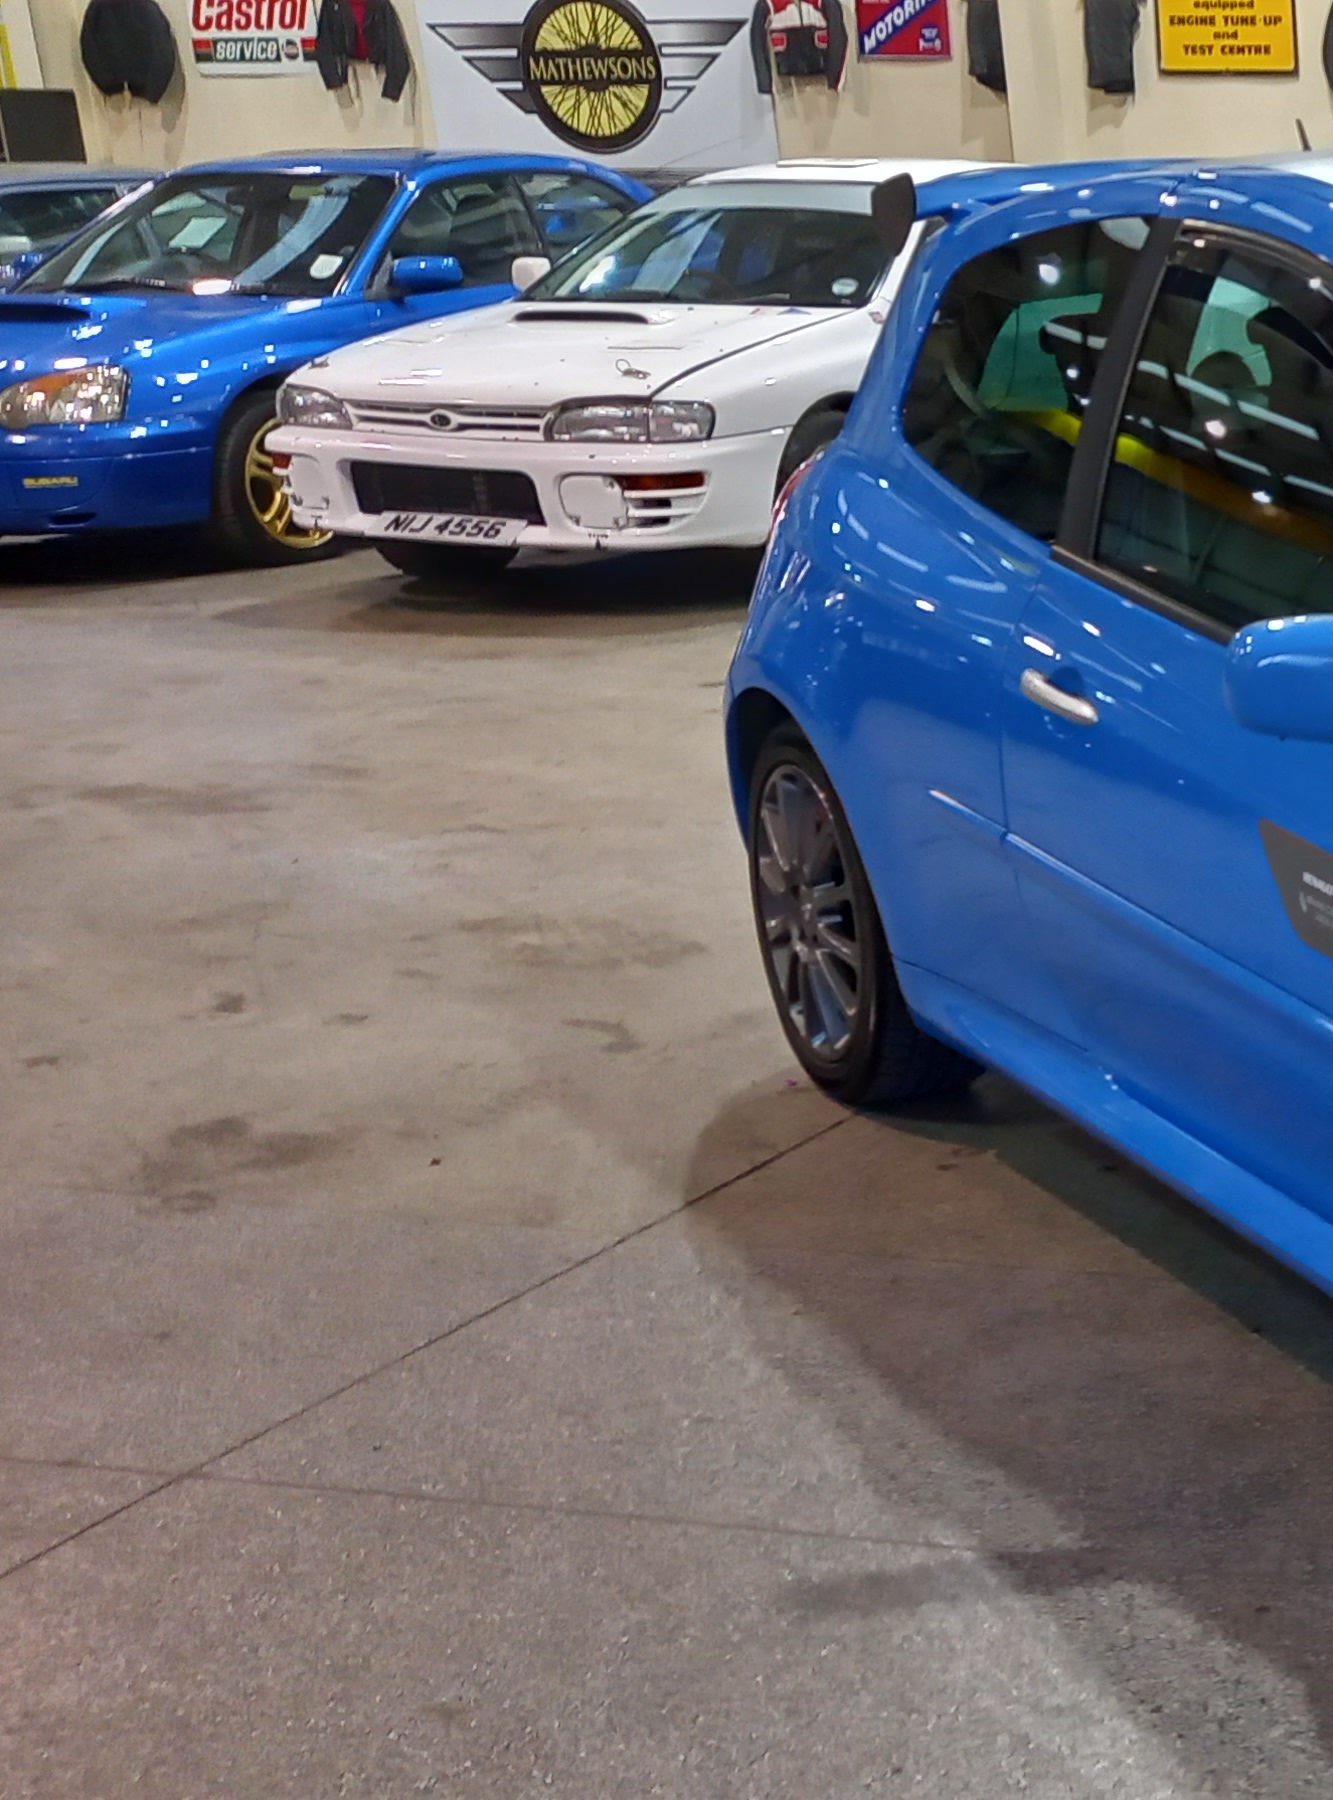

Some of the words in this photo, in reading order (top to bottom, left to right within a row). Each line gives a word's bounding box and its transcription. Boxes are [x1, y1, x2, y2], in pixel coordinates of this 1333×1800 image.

[192, 0, 308, 31] Castrol
[1169, 15, 1216, 27] ENGINE
[1213, 29, 1239, 40] and
[215, 41, 278, 60] service
[1183, 44, 1214, 56] TEST
[1220, 44, 1271, 56] CENTRE
[529, 55, 657, 81] MATHEWSONS
[384, 513, 434, 533] NIJ
[434, 515, 507, 539] 4556
